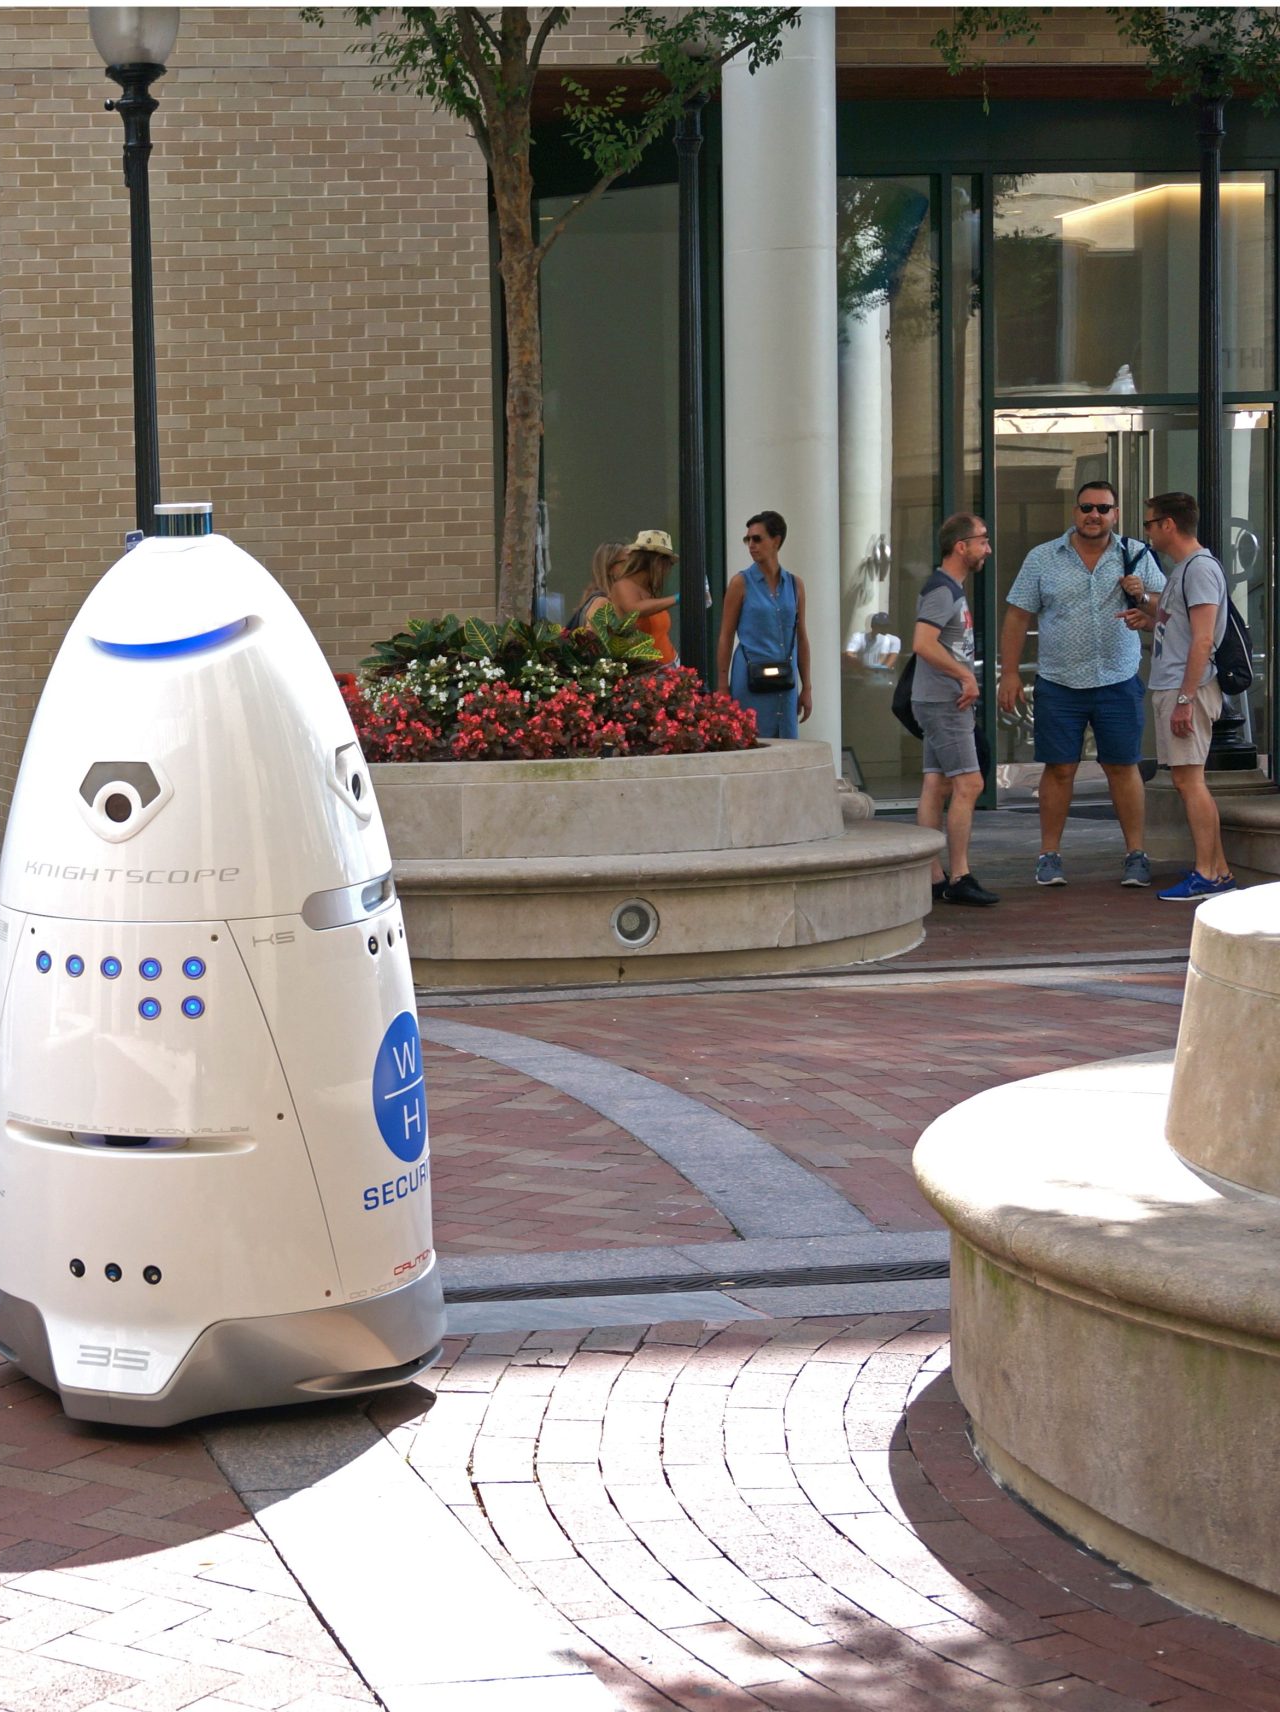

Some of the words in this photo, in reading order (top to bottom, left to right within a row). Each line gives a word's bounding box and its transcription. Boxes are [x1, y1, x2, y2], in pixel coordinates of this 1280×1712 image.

[392, 1036, 416, 1080] W
[403, 1098, 421, 1140] H
[363, 1158, 429, 1211] SECURI
[77, 1344, 151, 1372] 35
